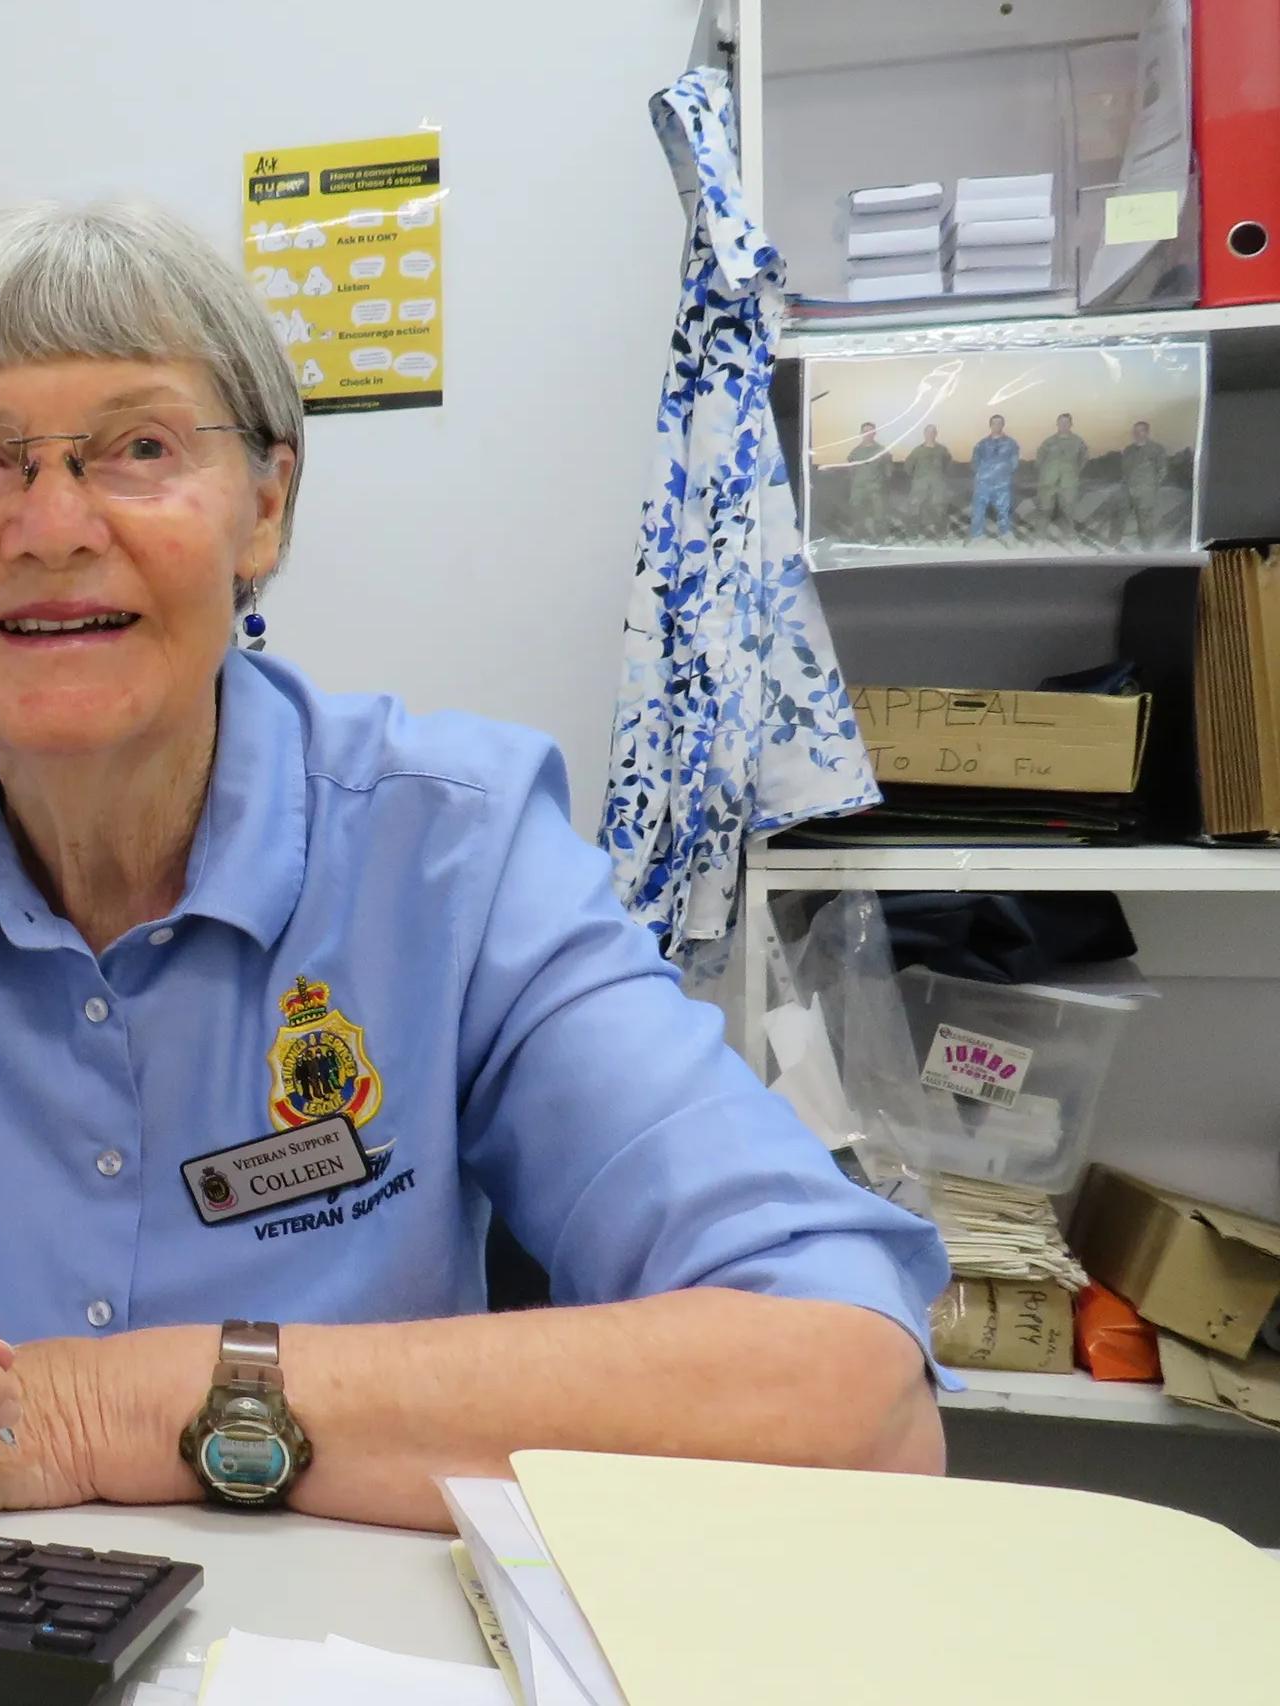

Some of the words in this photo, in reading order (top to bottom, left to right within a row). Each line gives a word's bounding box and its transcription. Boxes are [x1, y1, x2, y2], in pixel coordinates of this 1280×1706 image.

[330, 171, 354, 181] Have
[363, 164, 428, 178] conversation
[330, 182, 356, 193] using
[357, 178, 385, 190] these
[394, 175, 421, 187] steps
[337, 235, 356, 246] Ask
[358, 235, 366, 245] R
[367, 234, 375, 244] U
[376, 233, 398, 243] OK?
[337, 282, 370, 293] Listen
[338, 327, 394, 341] Encourage
[395, 325, 430, 337] action
[339, 377, 371, 387] Check
[373, 376, 383, 384] in
[852, 688, 1055, 728] APPEAL
[866, 746, 910, 772] To
[945, 1045, 1017, 1080] JUMBO
[924, 1077, 974, 1095] AUSTRALIA
[232, 1147, 287, 1172] VETERAN
[288, 1131, 341, 1157] SUPPORT
[249, 1155, 345, 1197] COLLEEN
[254, 1206, 344, 1241] VETERAN
[351, 1168, 416, 1220] SUPPORT
[1015, 1289, 1048, 1345] POPPY
